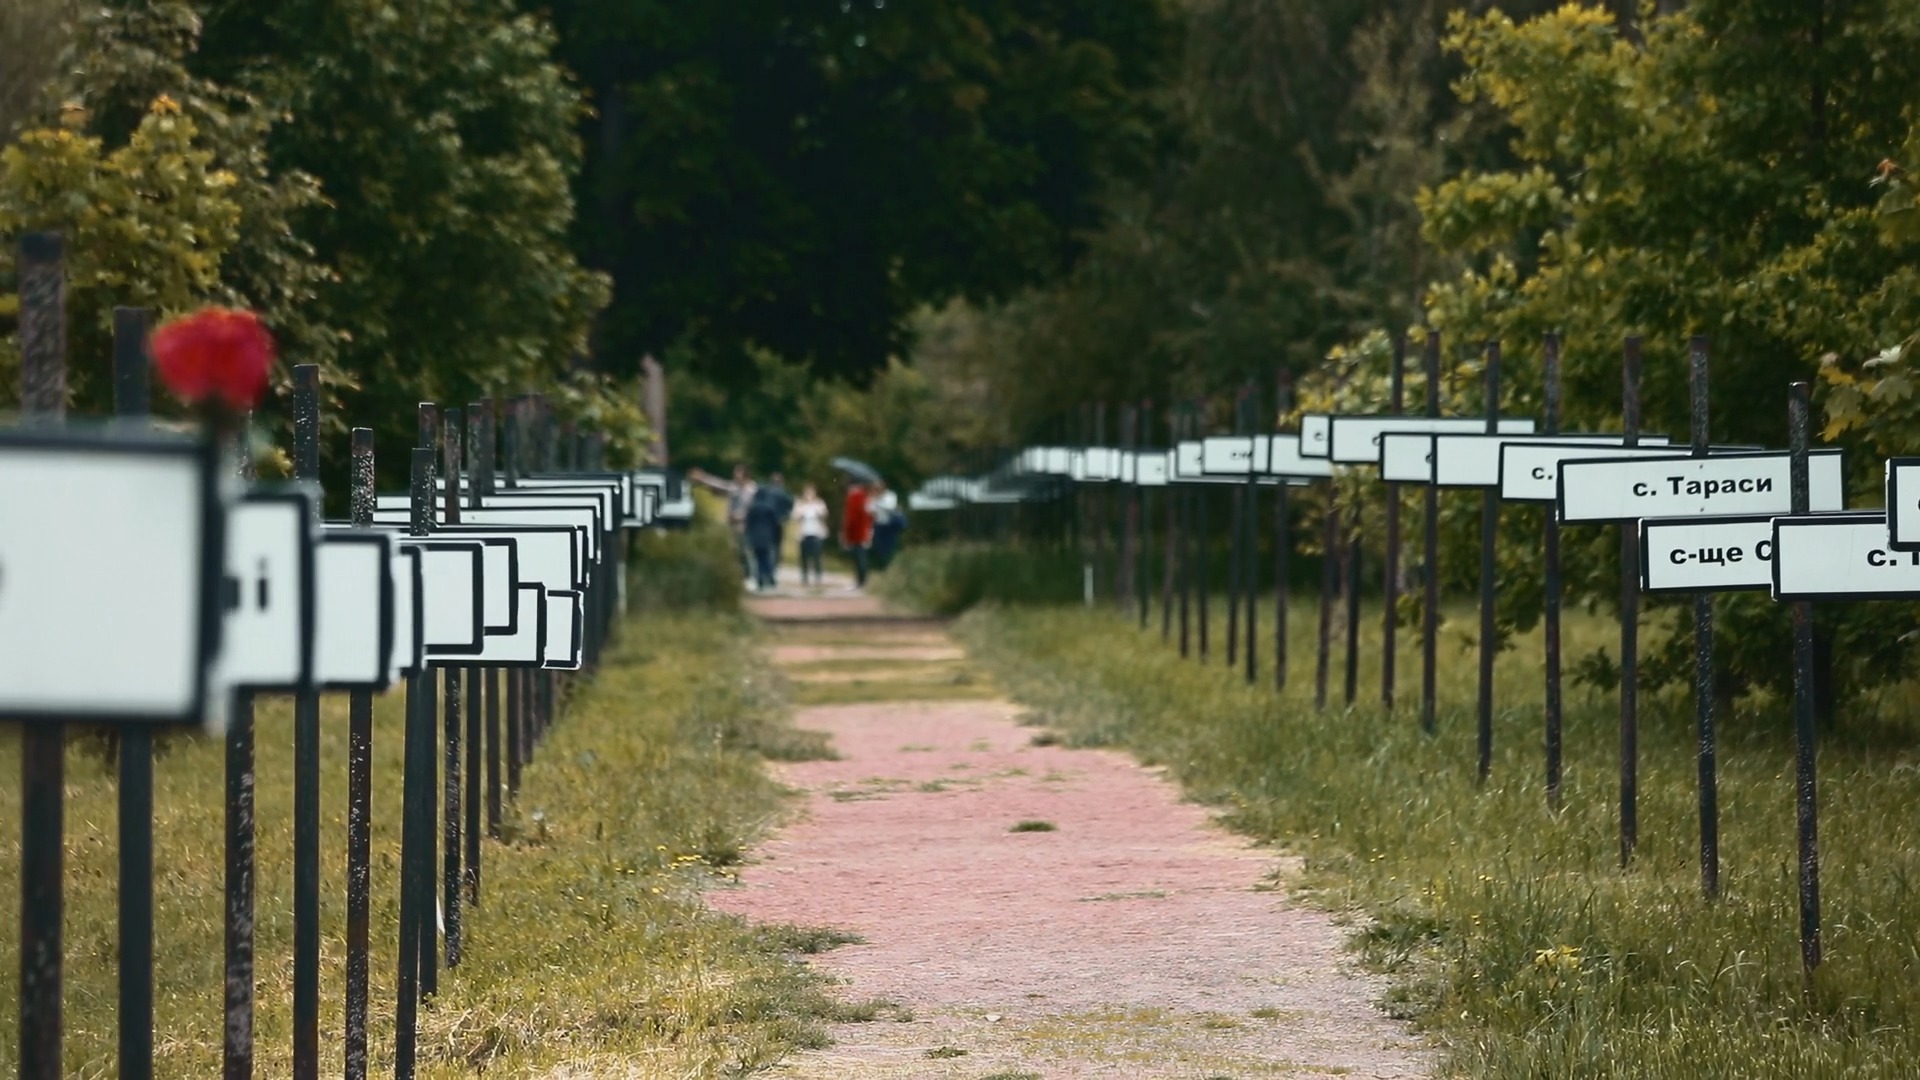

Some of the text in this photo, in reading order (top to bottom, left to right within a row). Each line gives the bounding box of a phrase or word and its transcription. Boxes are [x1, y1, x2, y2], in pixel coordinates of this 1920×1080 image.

[1633, 476, 1773, 500] с. Тараси
[1669, 546, 1743, 567] с-ще
[1867, 549, 1897, 567] с.
